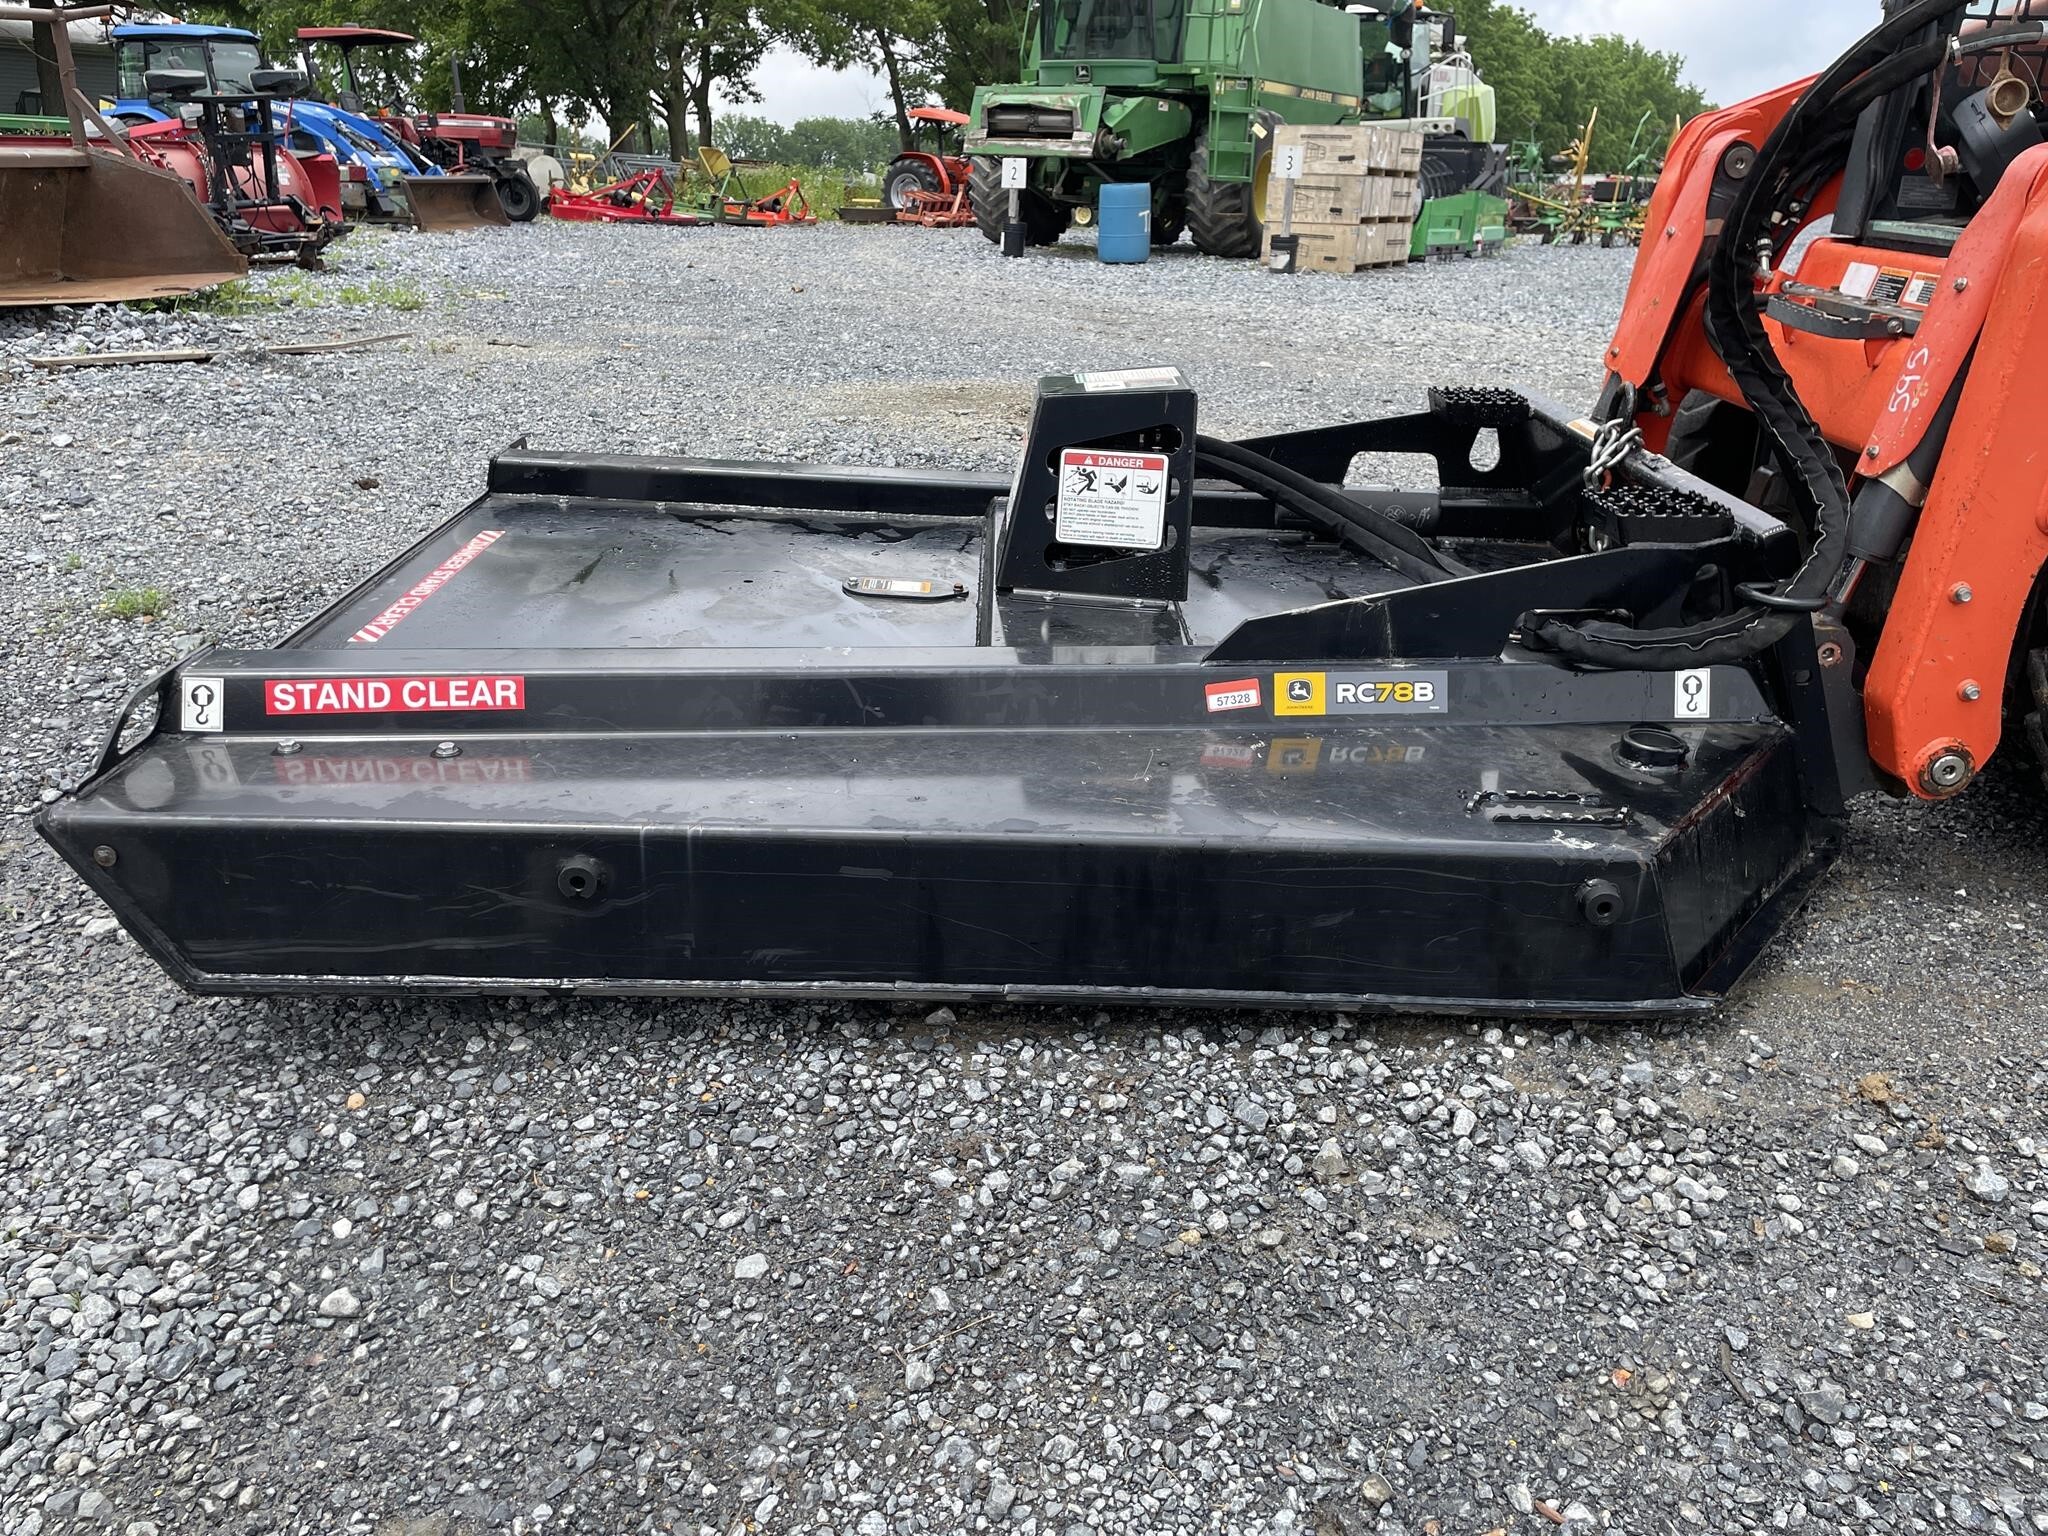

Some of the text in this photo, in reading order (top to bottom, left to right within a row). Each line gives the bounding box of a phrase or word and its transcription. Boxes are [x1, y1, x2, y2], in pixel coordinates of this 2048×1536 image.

[1286, 155, 1293, 171] 3
[1011, 166, 1017, 181] 2
[1888, 347, 1929, 412] 595
[1098, 456, 1144, 468] DANGER
[371, 538, 489, 626] DANGER STAND CLEAR
[273, 679, 517, 712] STAND CLEAR
[1216, 693, 1251, 707] 57328
[1336, 681, 1435, 704] RC78B
